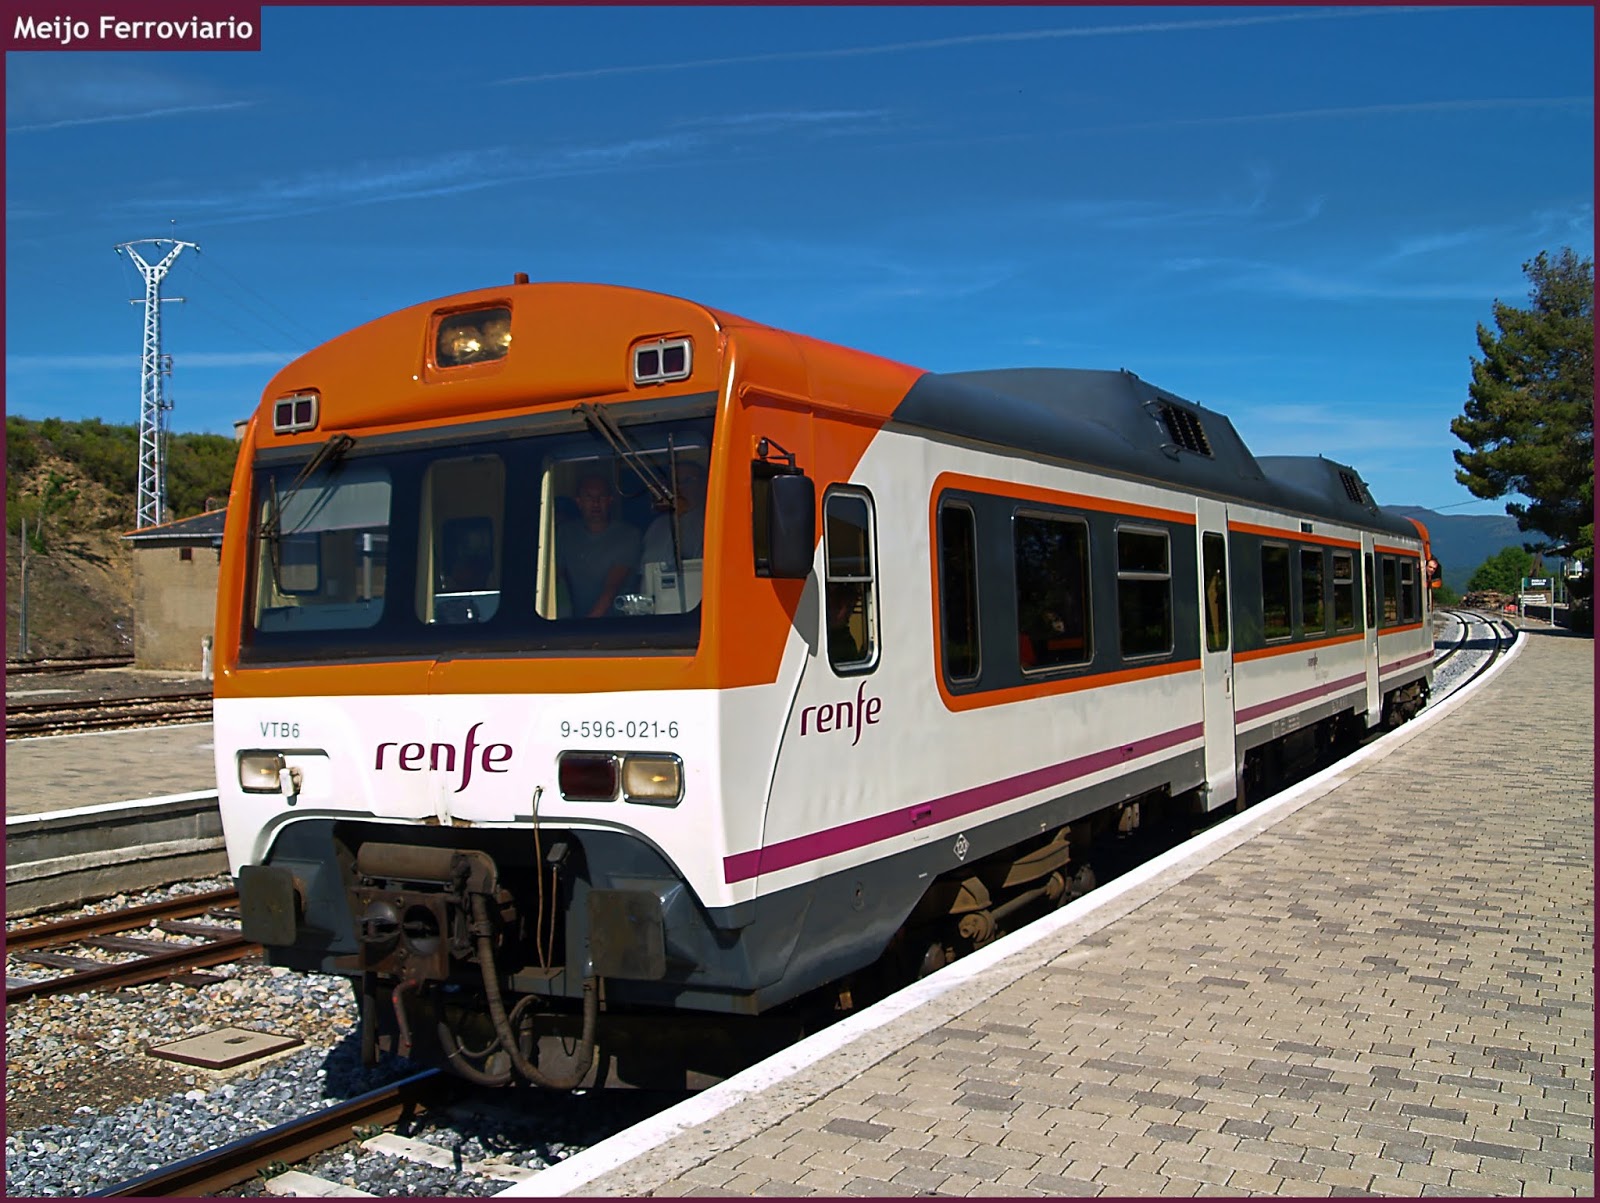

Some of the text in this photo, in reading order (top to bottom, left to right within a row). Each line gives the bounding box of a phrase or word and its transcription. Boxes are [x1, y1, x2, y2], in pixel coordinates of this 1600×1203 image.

[260, 721, 300, 738] VTB6
[560, 720, 679, 738] 9-596-021-6
[801, 680, 881, 746] renfe
[375, 721, 513, 793] renfe
